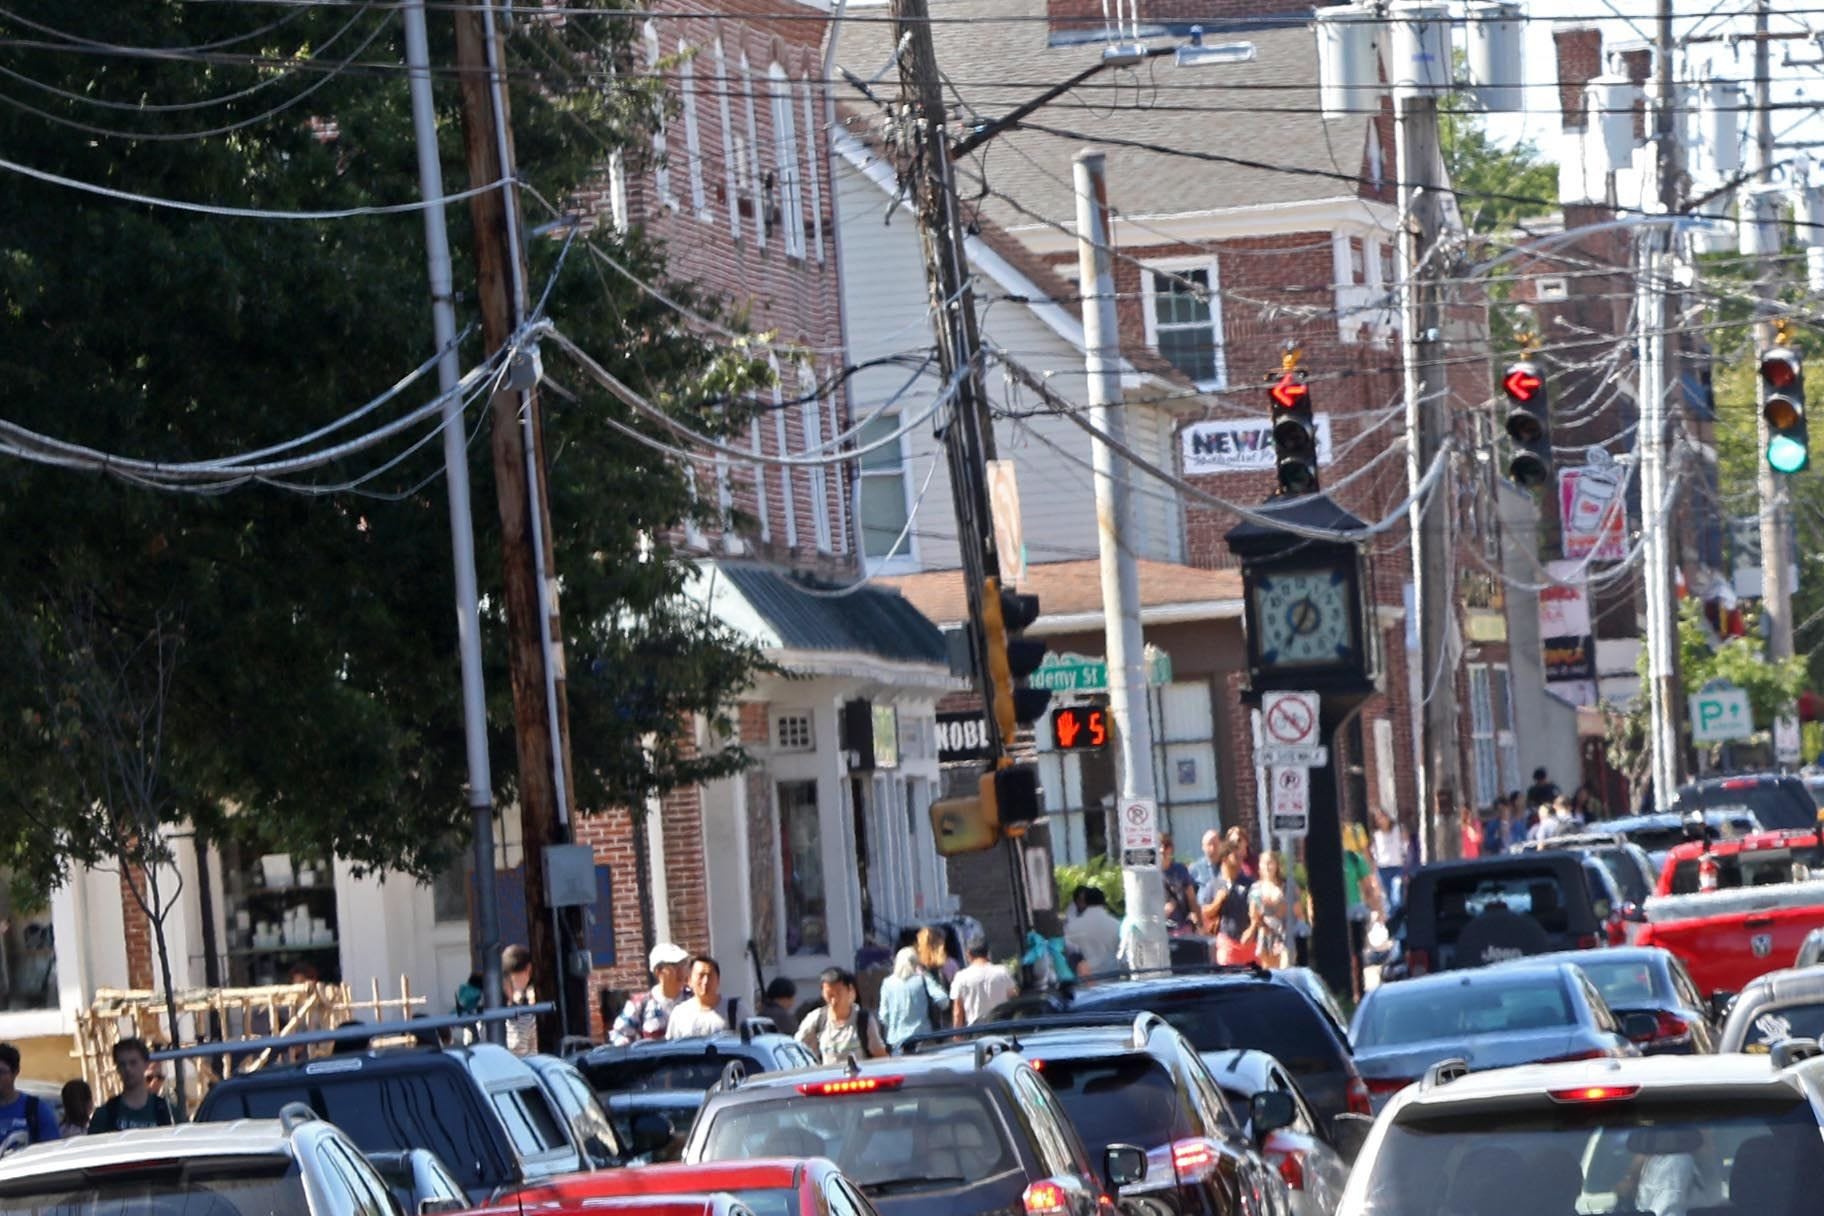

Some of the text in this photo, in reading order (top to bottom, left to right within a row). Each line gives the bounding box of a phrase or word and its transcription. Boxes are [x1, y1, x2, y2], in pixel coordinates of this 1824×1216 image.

[1029, 666, 1098, 690] demy St
[934, 718, 991, 752] NOBL
[1089, 711, 1105, 746] 5
